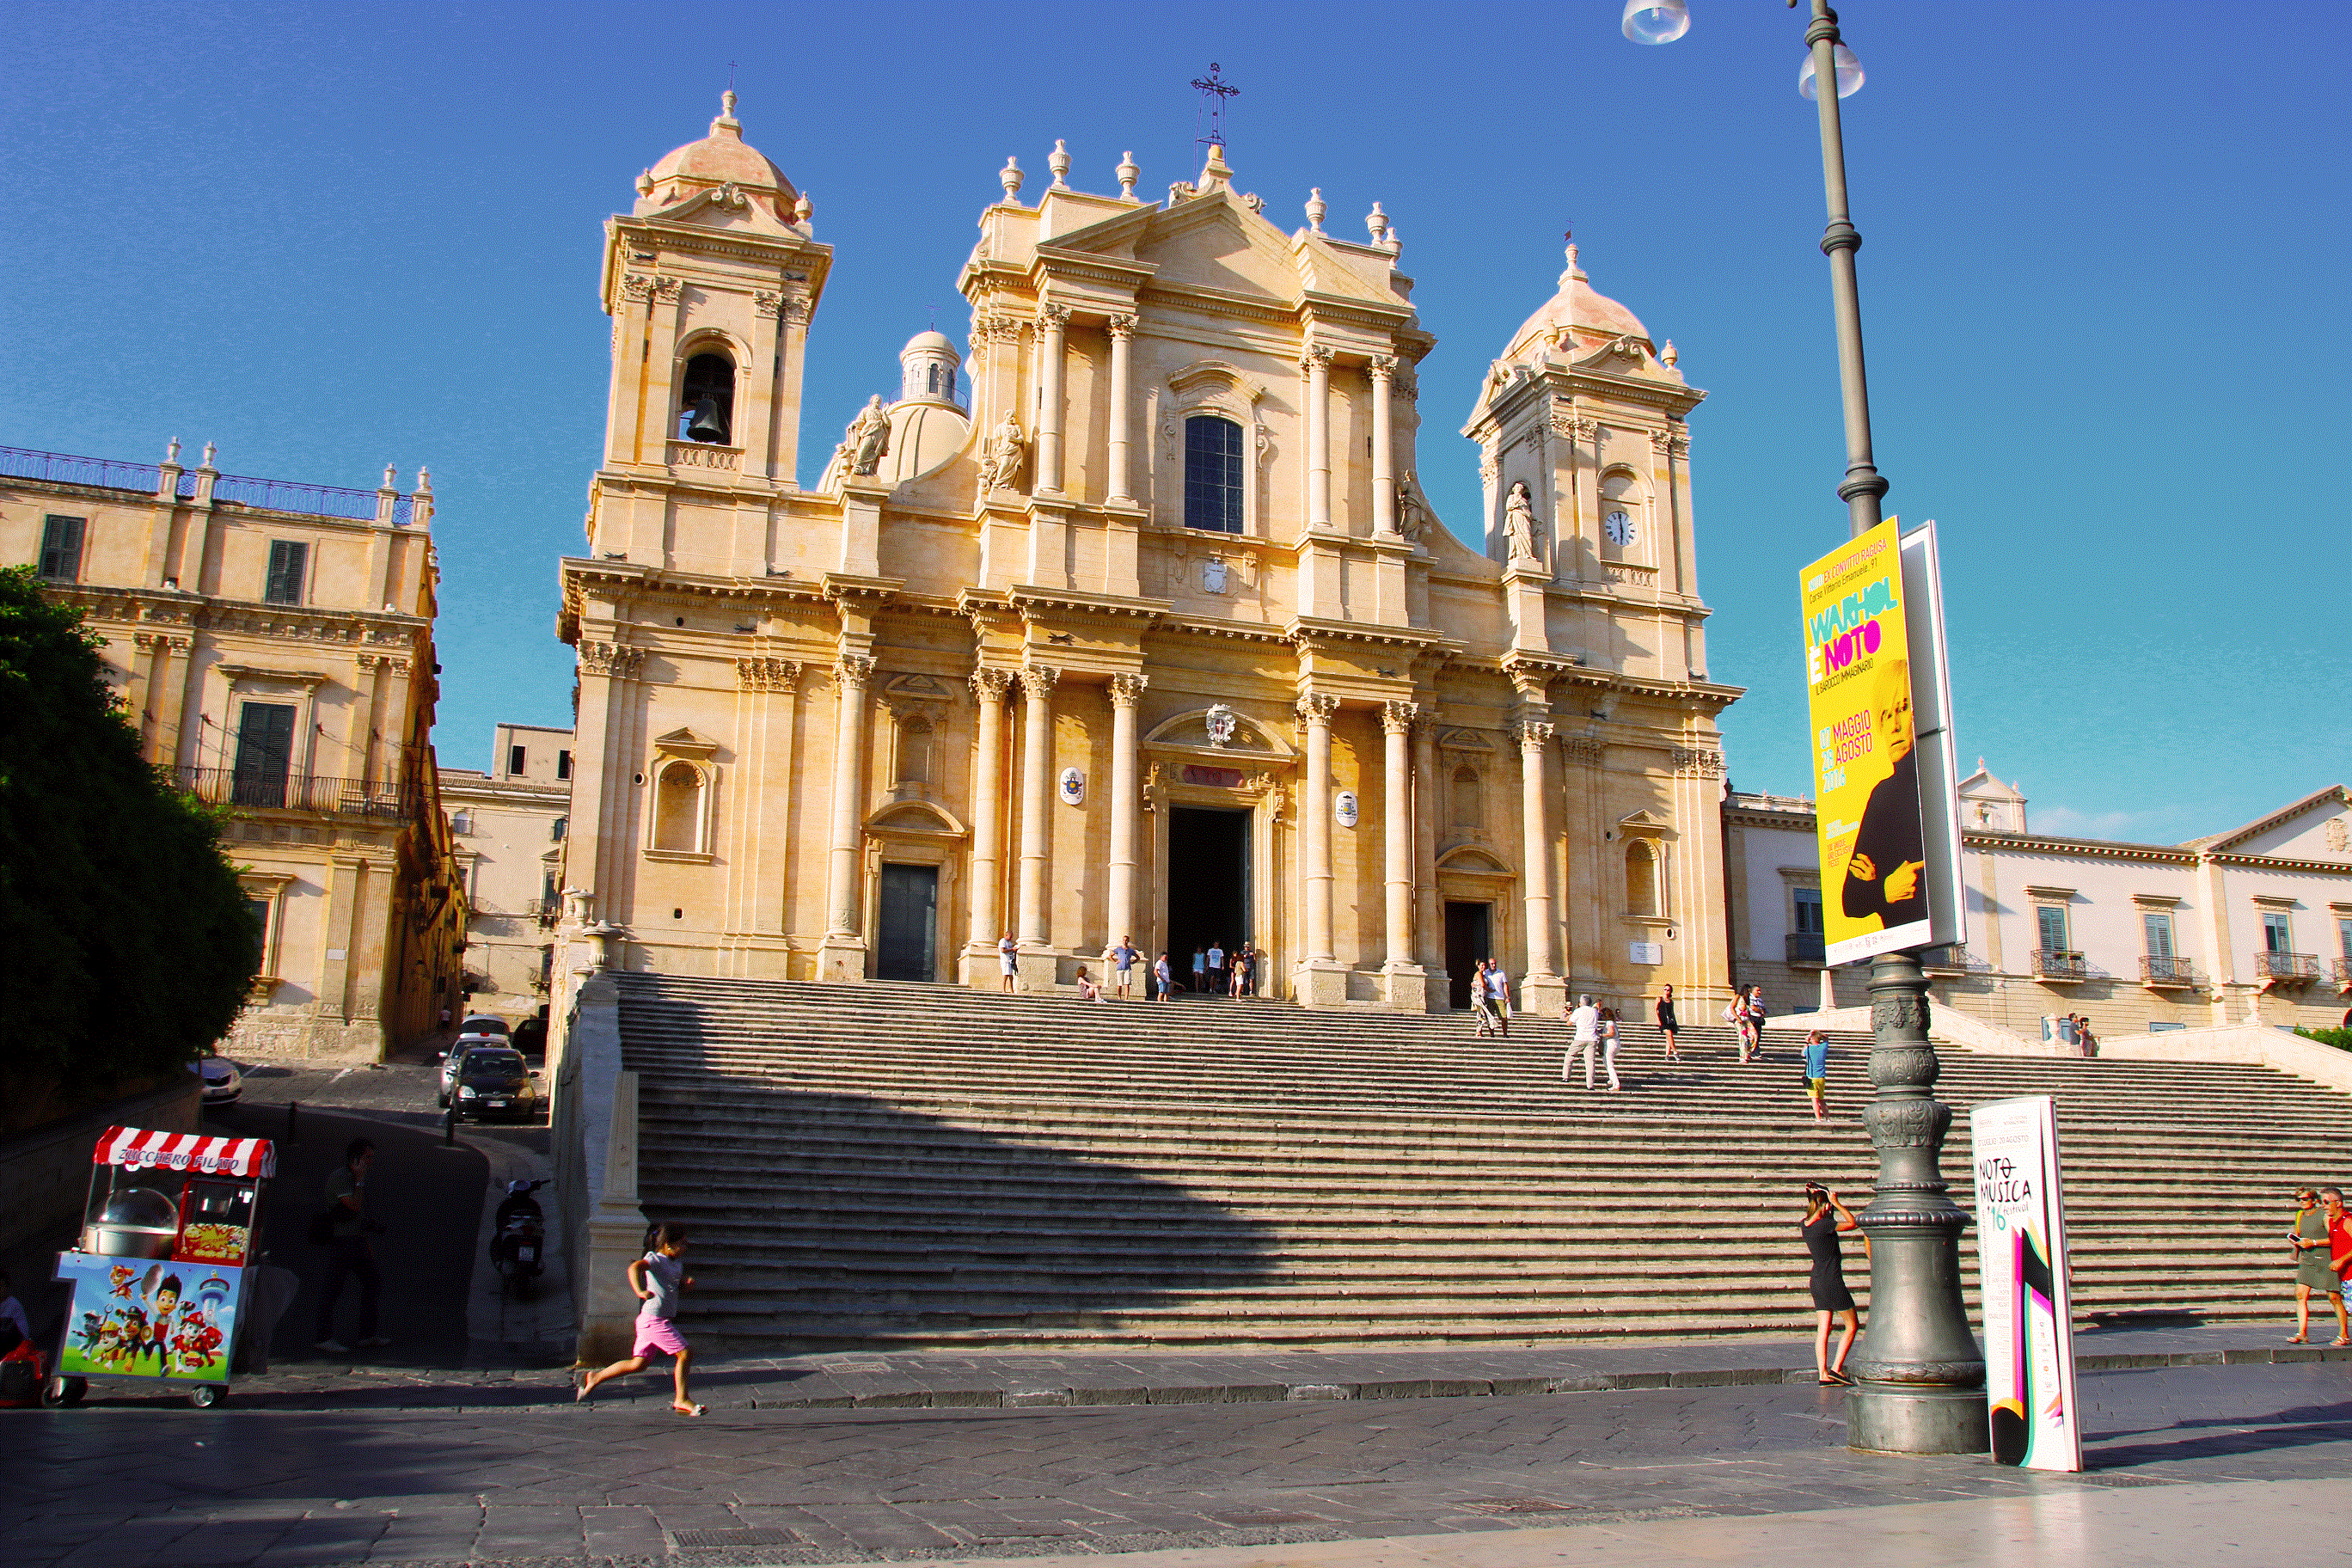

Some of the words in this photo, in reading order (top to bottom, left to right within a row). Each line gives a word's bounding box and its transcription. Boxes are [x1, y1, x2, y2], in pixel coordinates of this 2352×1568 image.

[1824, 568, 1833, 583] EX
[1833, 553, 1862, 579] CONVITTO
[1861, 538, 1888, 561] RAGUSA
[1809, 591, 1823, 604] Corso
[1809, 576, 1898, 647] WARHOL
[1824, 620, 1882, 677] NOTO
[1819, 675, 1840, 694] BAROCCO
[1841, 658, 1874, 682] IMMAGINARIO
[1833, 709, 1871, 744] MAGGIO
[1835, 732, 1873, 766] AGOSTO
[1822, 766, 1847, 794] 2016
[2006, 1134, 2030, 1143] AGOSTO
[119, 1148, 192, 1165] ZUCCHERO
[193, 1155, 239, 1170] FILATO
[1979, 1157, 2017, 1181] NOTO
[1981, 1179, 2032, 1204] MUSICA
[2003, 1201, 2029, 1216] festival
